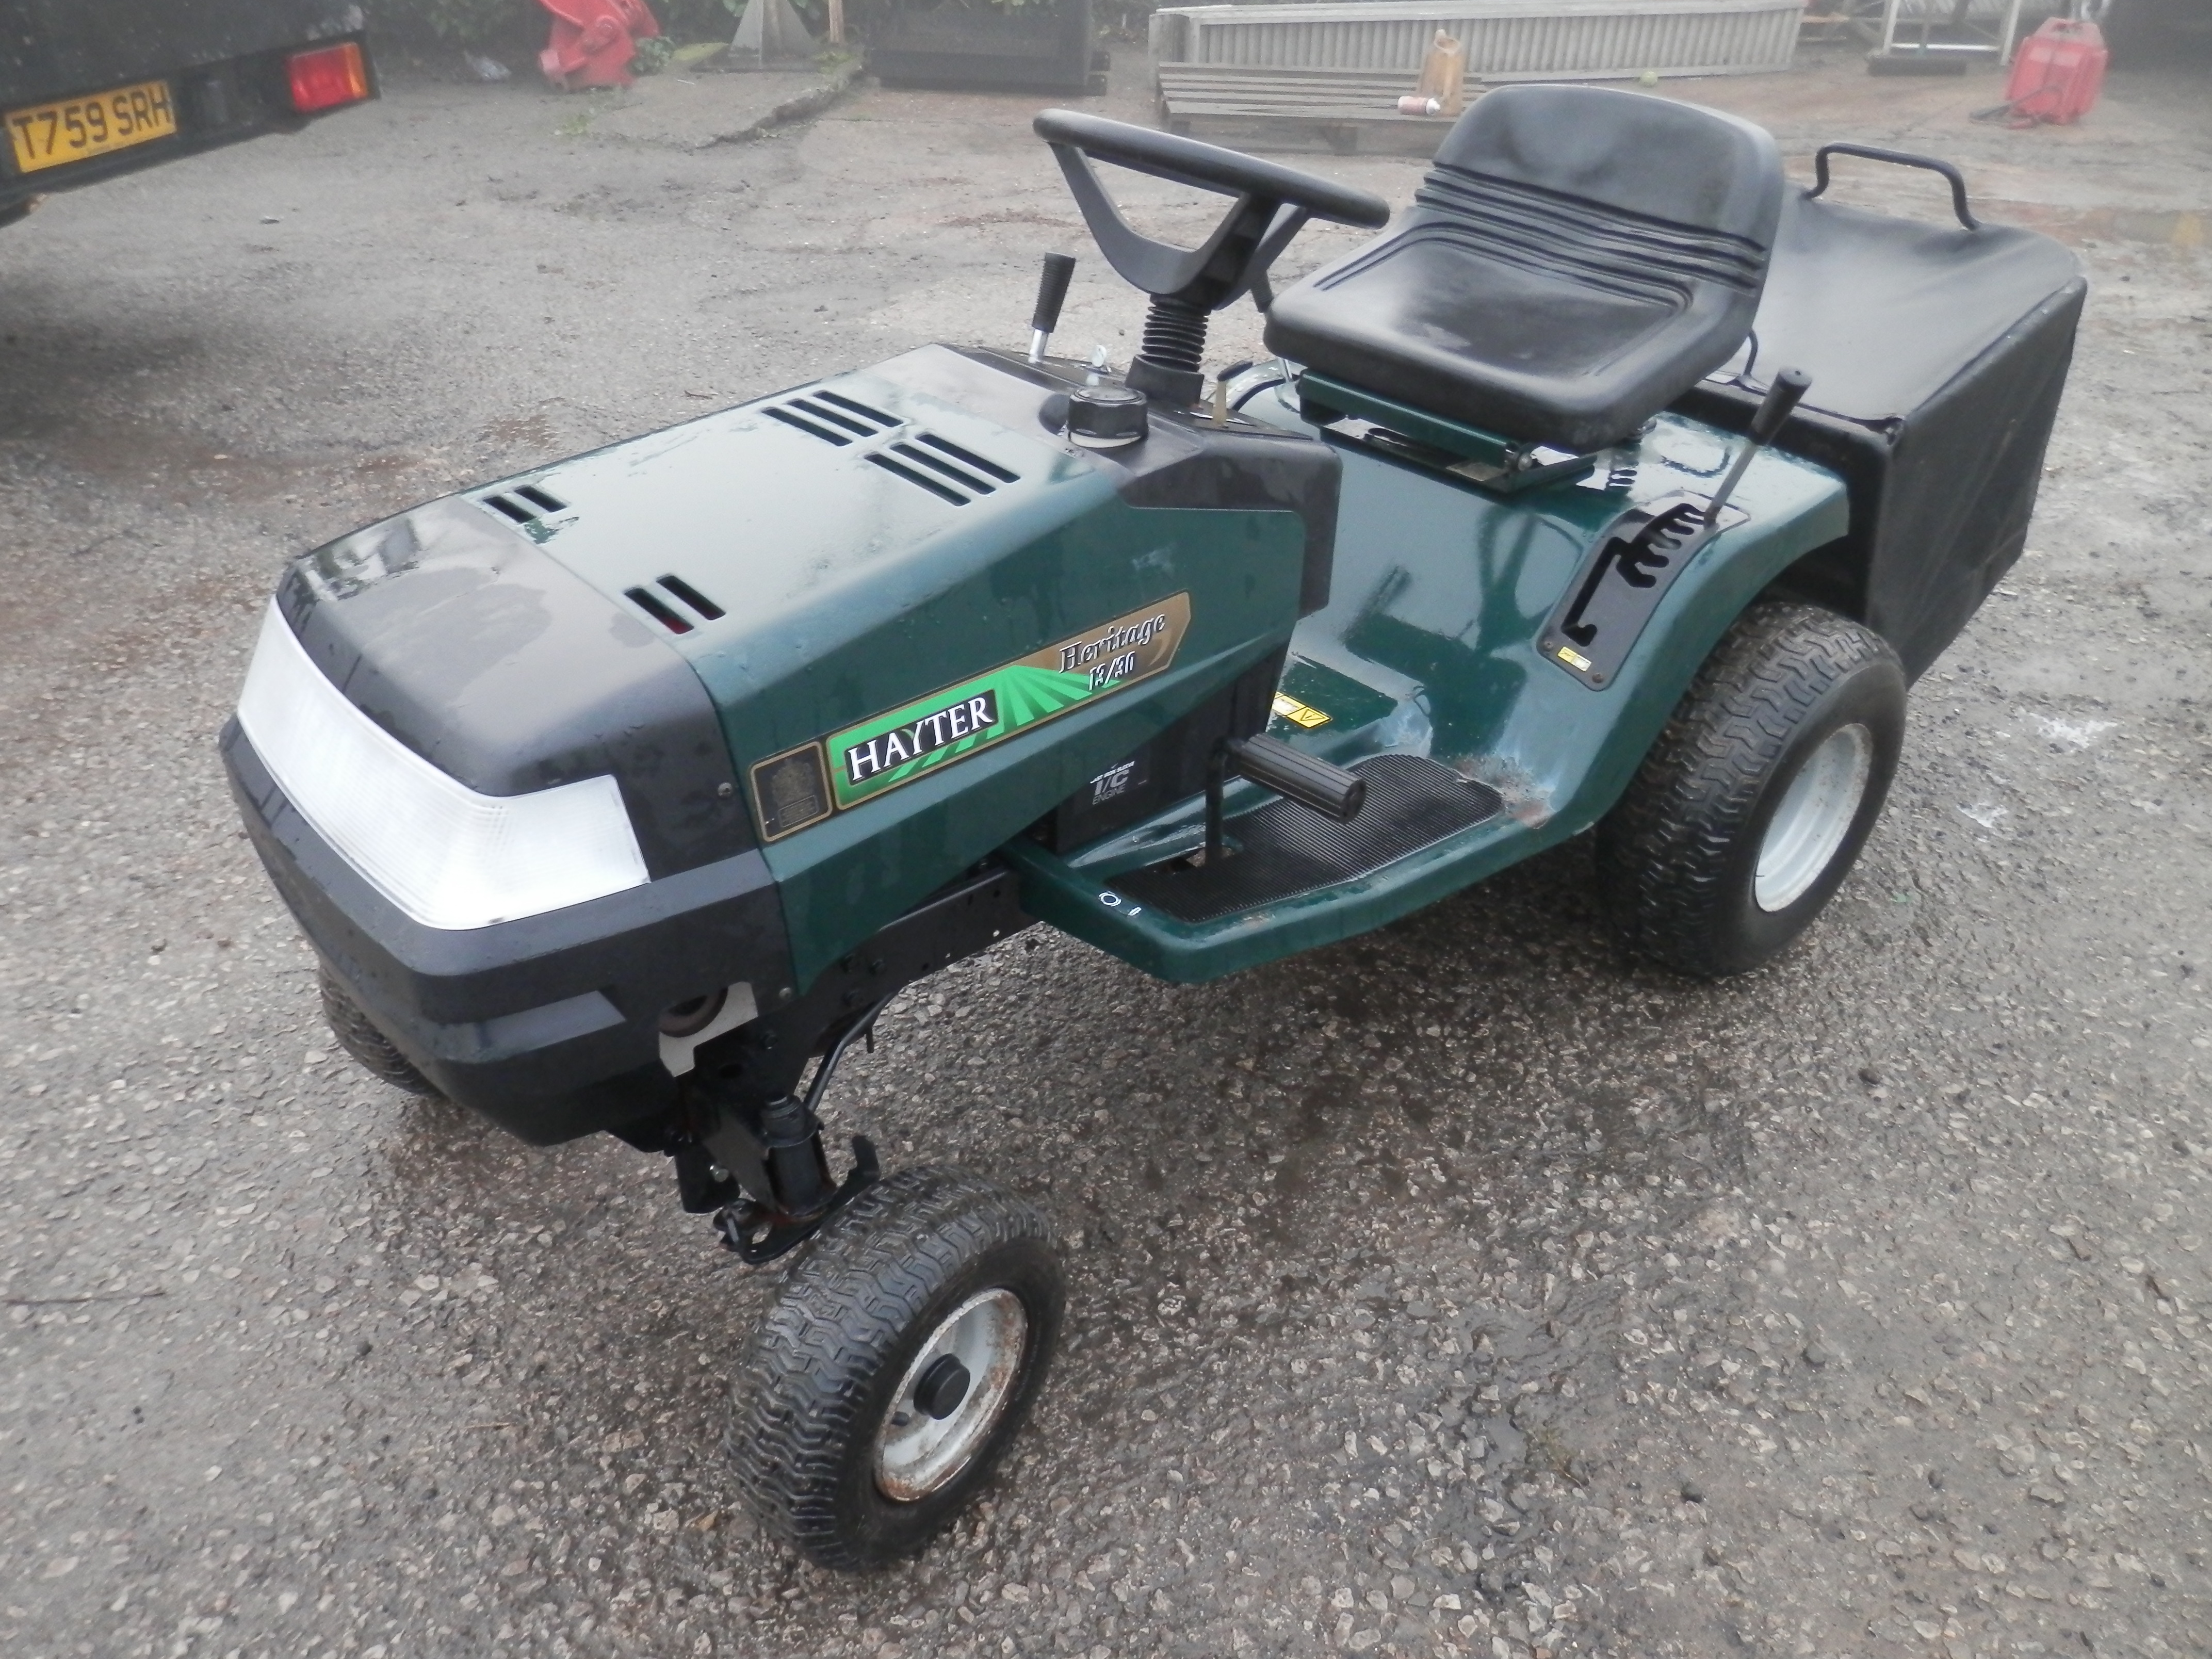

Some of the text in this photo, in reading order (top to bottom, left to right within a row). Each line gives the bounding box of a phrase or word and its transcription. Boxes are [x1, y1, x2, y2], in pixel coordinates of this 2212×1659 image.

[12, 85, 170, 160] T759 SRH
[1059, 614, 1165, 674] Heritage
[848, 697, 993, 781] HAYTER
[1092, 784, 1126, 805] ENGINE
